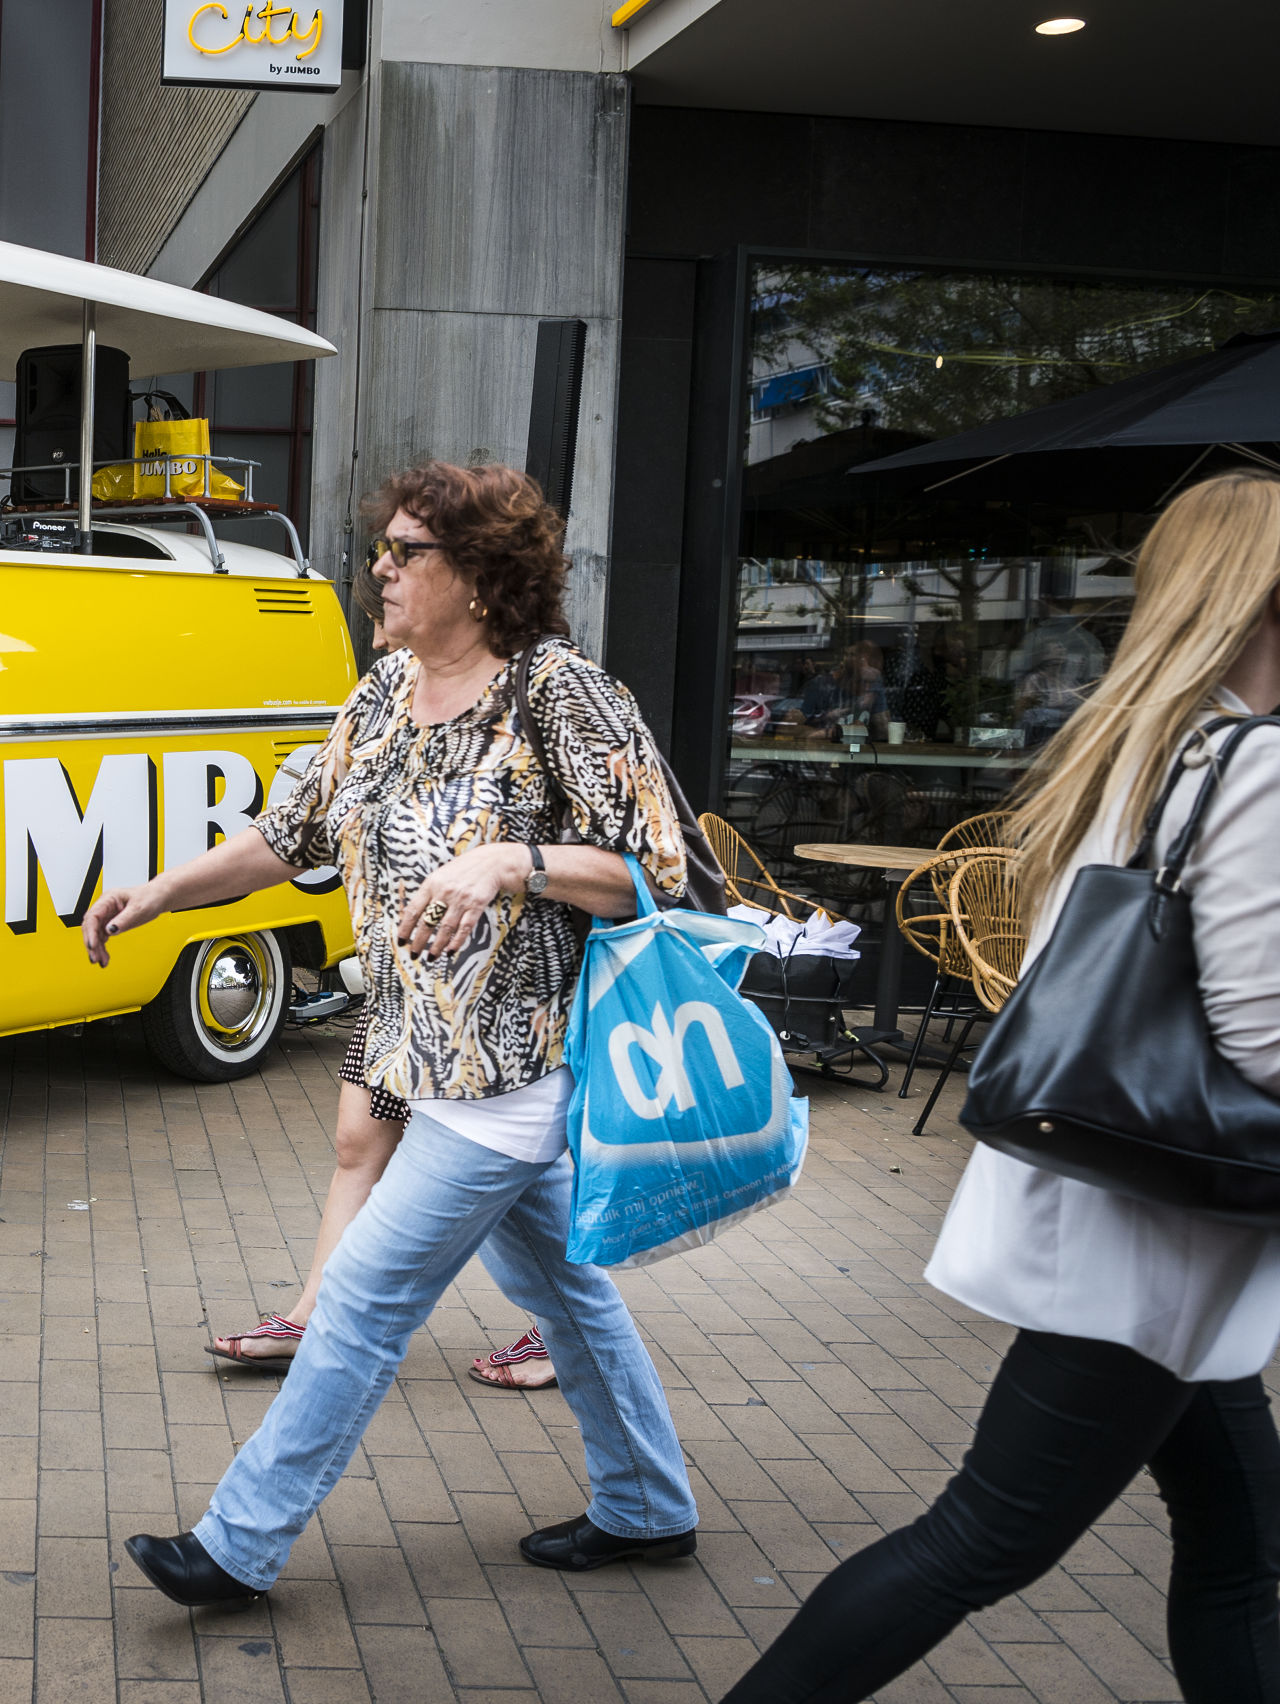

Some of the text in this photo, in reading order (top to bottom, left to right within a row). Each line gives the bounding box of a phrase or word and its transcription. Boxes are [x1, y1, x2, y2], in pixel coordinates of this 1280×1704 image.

[188, 0, 323, 61] City
[269, 63, 321, 75] by JUMBO
[139, 460, 198, 476] JUMBO
[32, 521, 67, 532] Pioneer
[723, 1178, 762, 1200] Gewoon
[624, 1198, 646, 1216] mij
